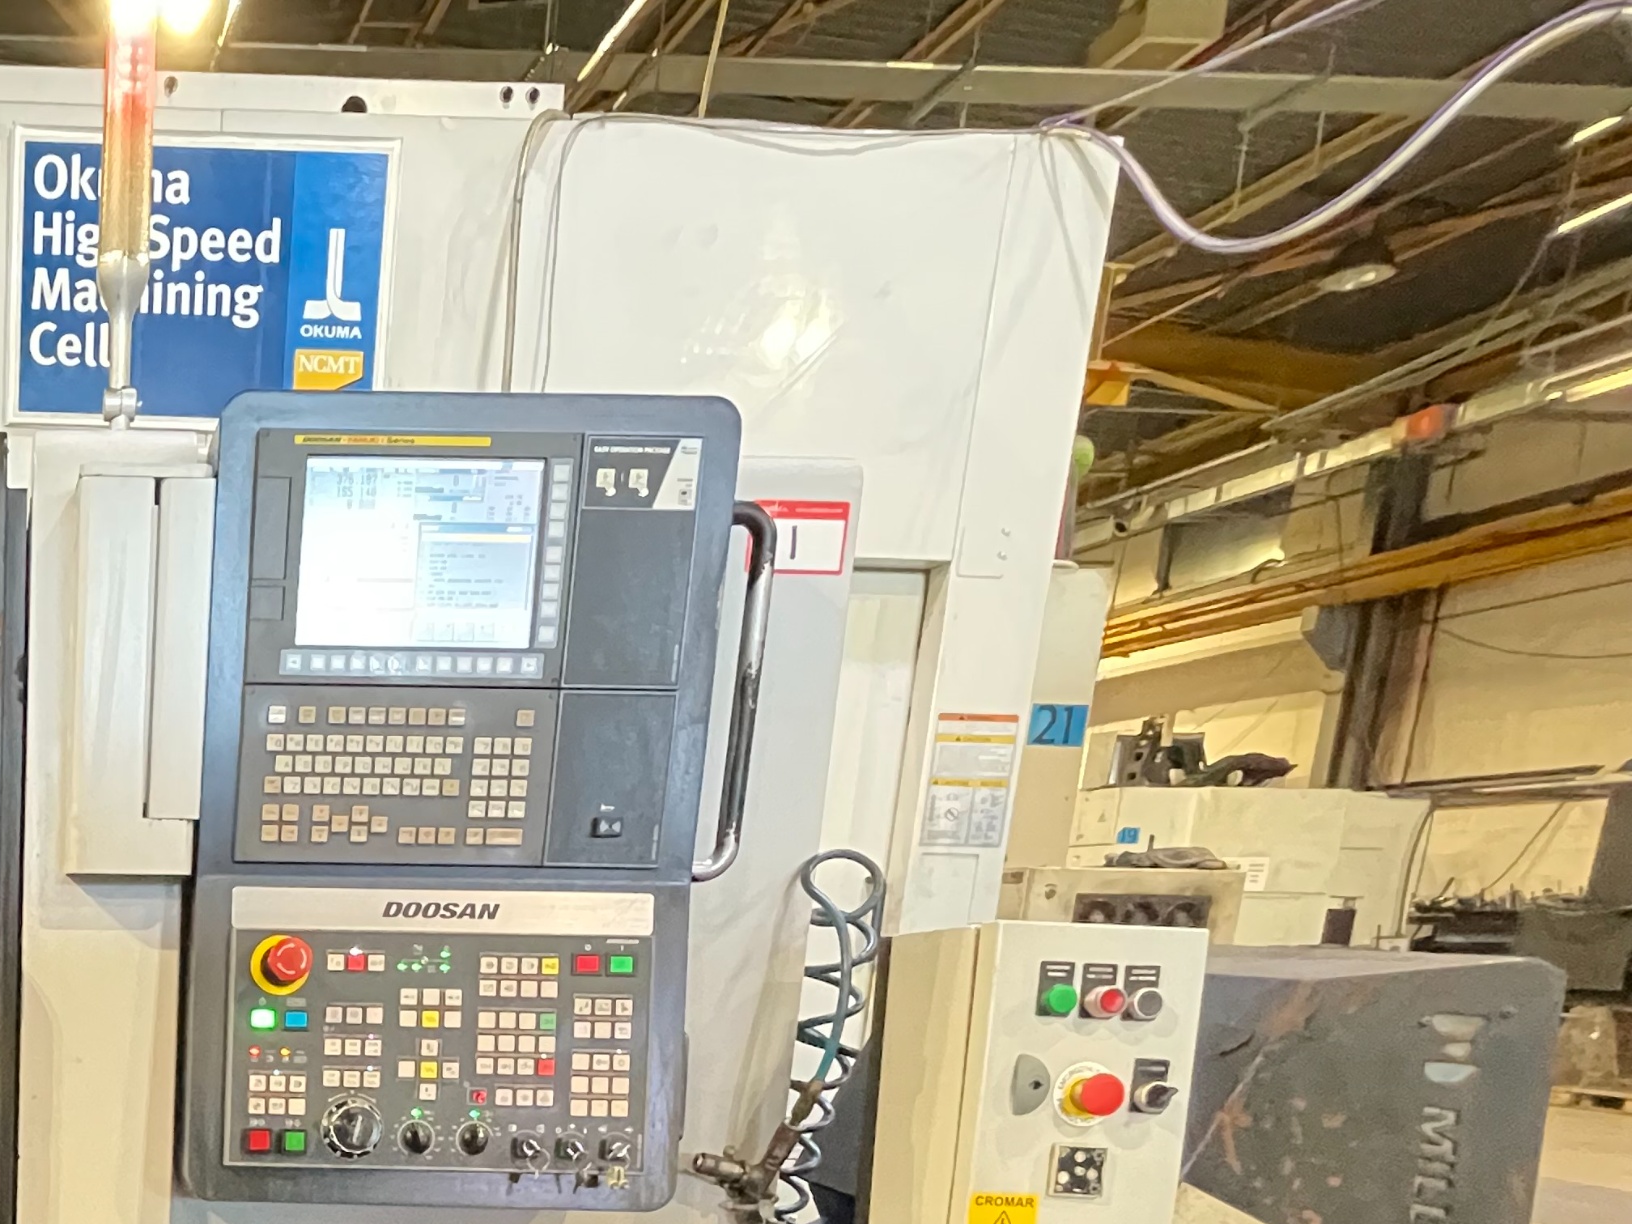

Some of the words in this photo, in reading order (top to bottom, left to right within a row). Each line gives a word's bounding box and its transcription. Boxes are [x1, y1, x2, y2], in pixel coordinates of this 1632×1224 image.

[34, 153, 190, 205] Oka
[33, 209, 100, 268] Hig
[149, 213, 281, 272] Speed
[31, 266, 263, 329] Maining
[29, 320, 111, 368] Cell
[299, 324, 363, 340] OKUMA
[298, 354, 361, 375] NCMT
[1031, 704, 1075, 745] 21
[382, 901, 501, 921] DOOSAN
[974, 1195, 1035, 1209] CROMAR
